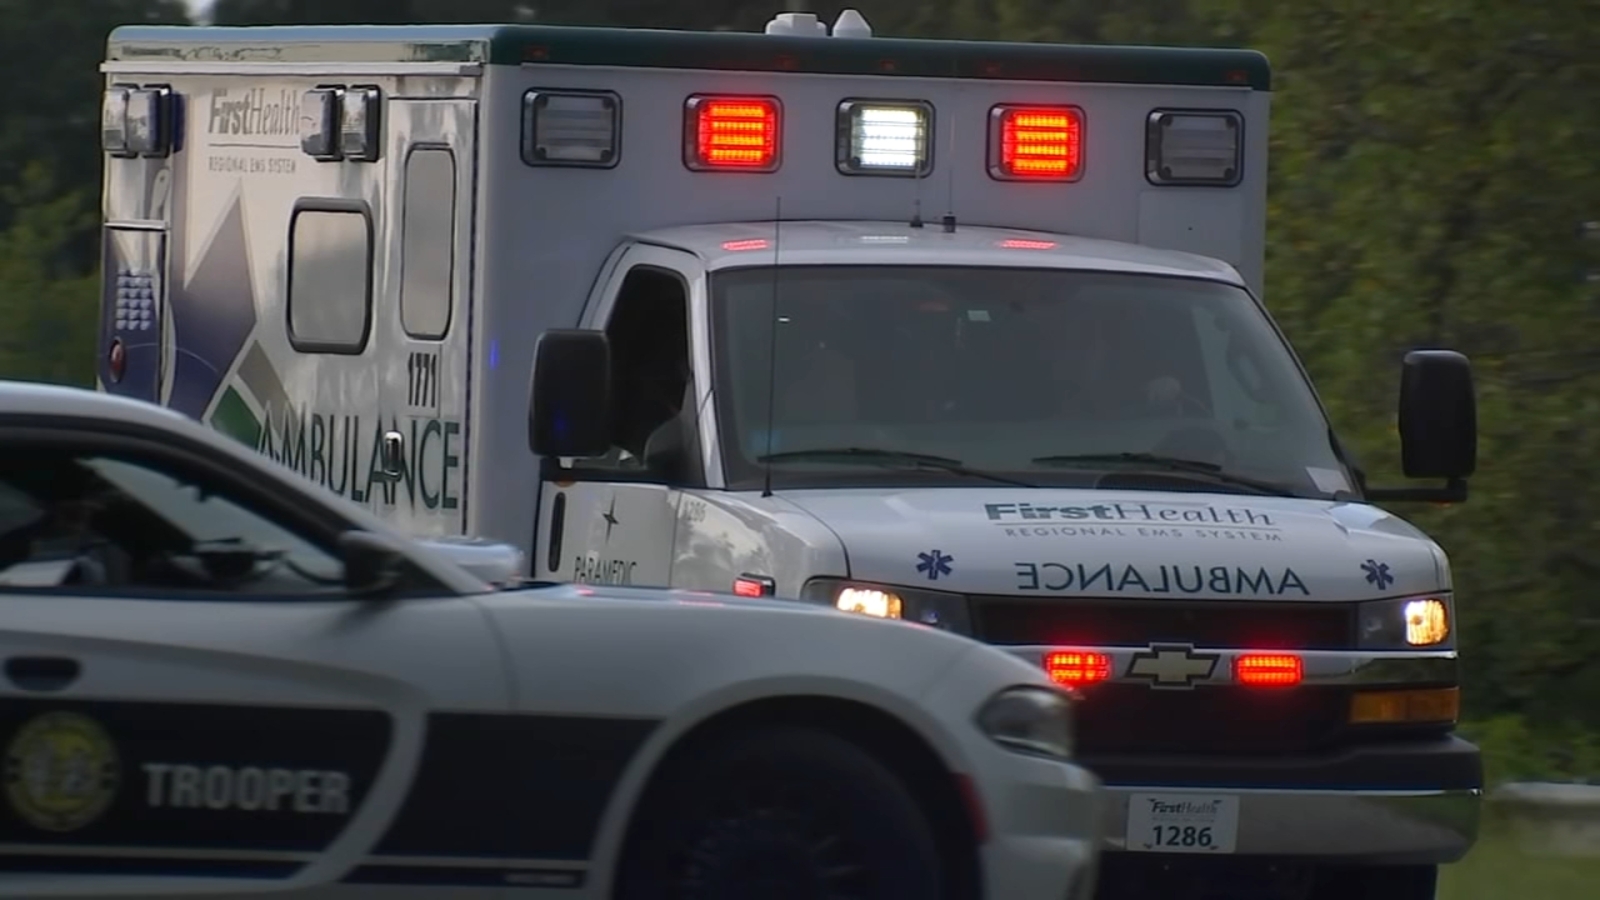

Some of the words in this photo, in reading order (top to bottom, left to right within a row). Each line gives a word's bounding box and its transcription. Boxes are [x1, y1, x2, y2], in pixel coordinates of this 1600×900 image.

[208, 88, 300, 135] FirstHealth
[268, 157, 296, 174] SYSTEM
[408, 352, 437, 408] 1771
[257, 406, 461, 512] AMBULANCE
[984, 503, 1275, 526] FirstHealth
[1005, 526, 1126, 538] REGIONAL
[1138, 528, 1184, 539] EMS
[1194, 530, 1283, 542] SYSTEM
[574, 556, 637, 585] PARAMEDIC
[142, 762, 351, 815] TROOPER
[1151, 801, 1218, 814] FirstHealth
[1153, 825, 1212, 847] 1286
